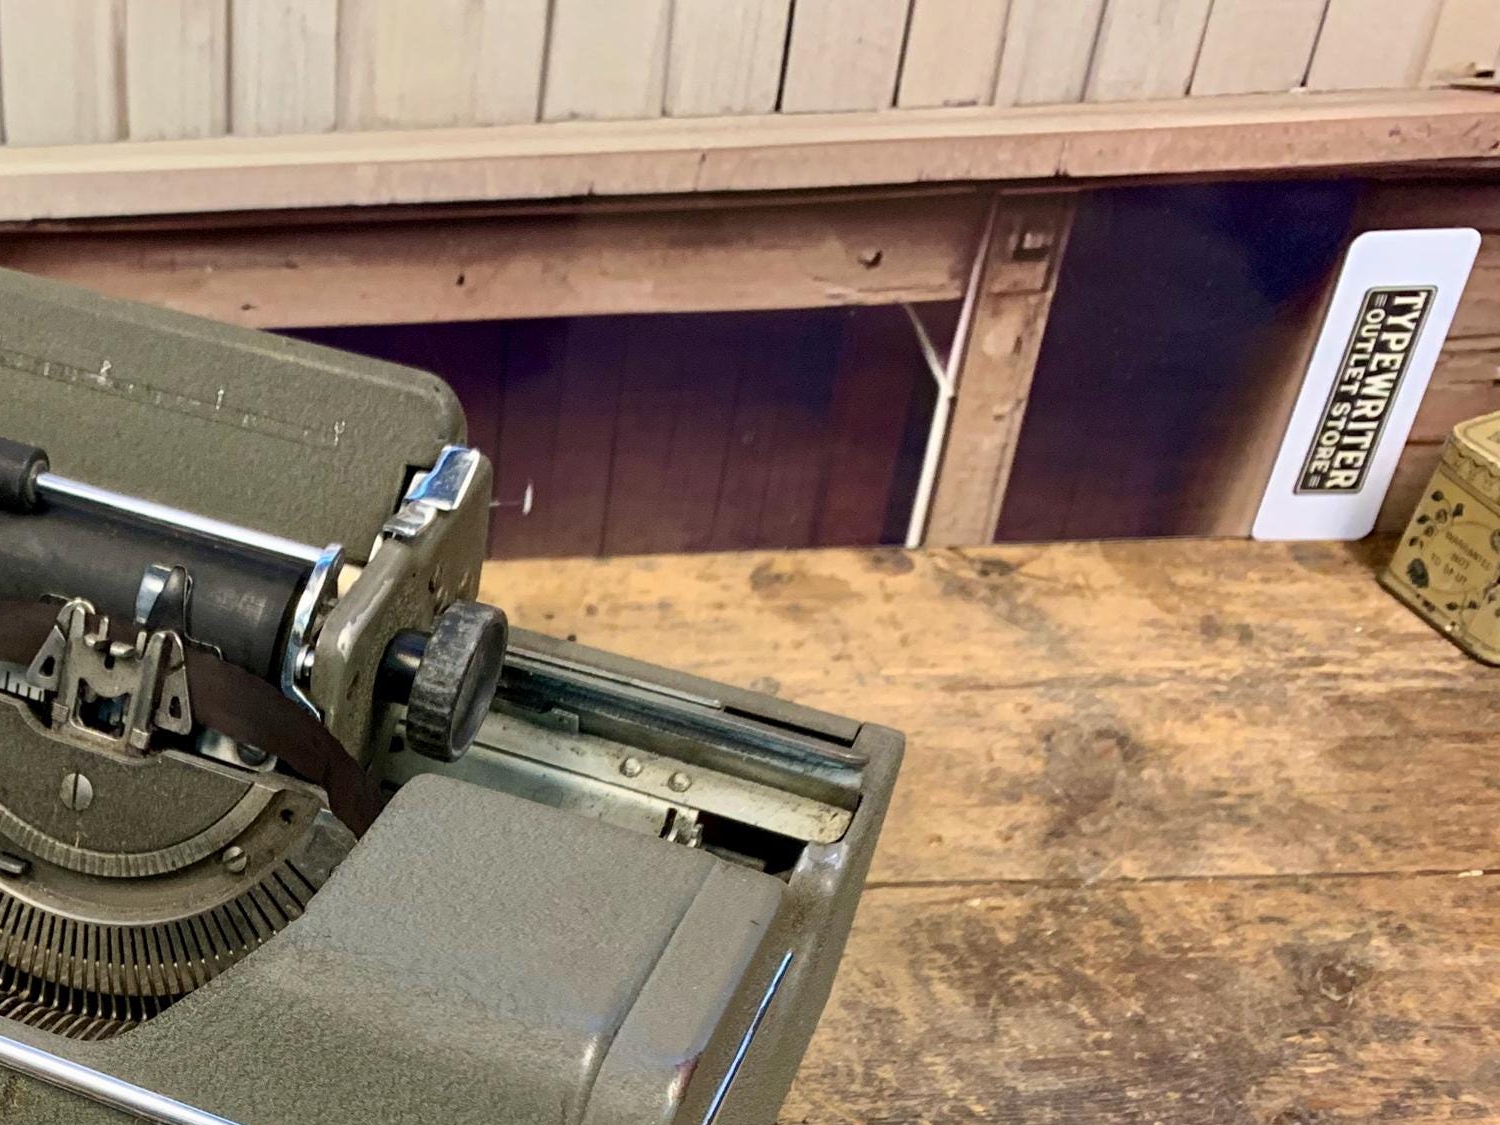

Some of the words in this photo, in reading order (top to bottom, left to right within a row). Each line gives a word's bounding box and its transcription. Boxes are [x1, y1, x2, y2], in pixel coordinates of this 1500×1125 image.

[1325, 291, 1428, 489] TYPEWRITER
[1340, 308, 1386, 395] OUTLET
[1310, 401, 1352, 474] STORE
